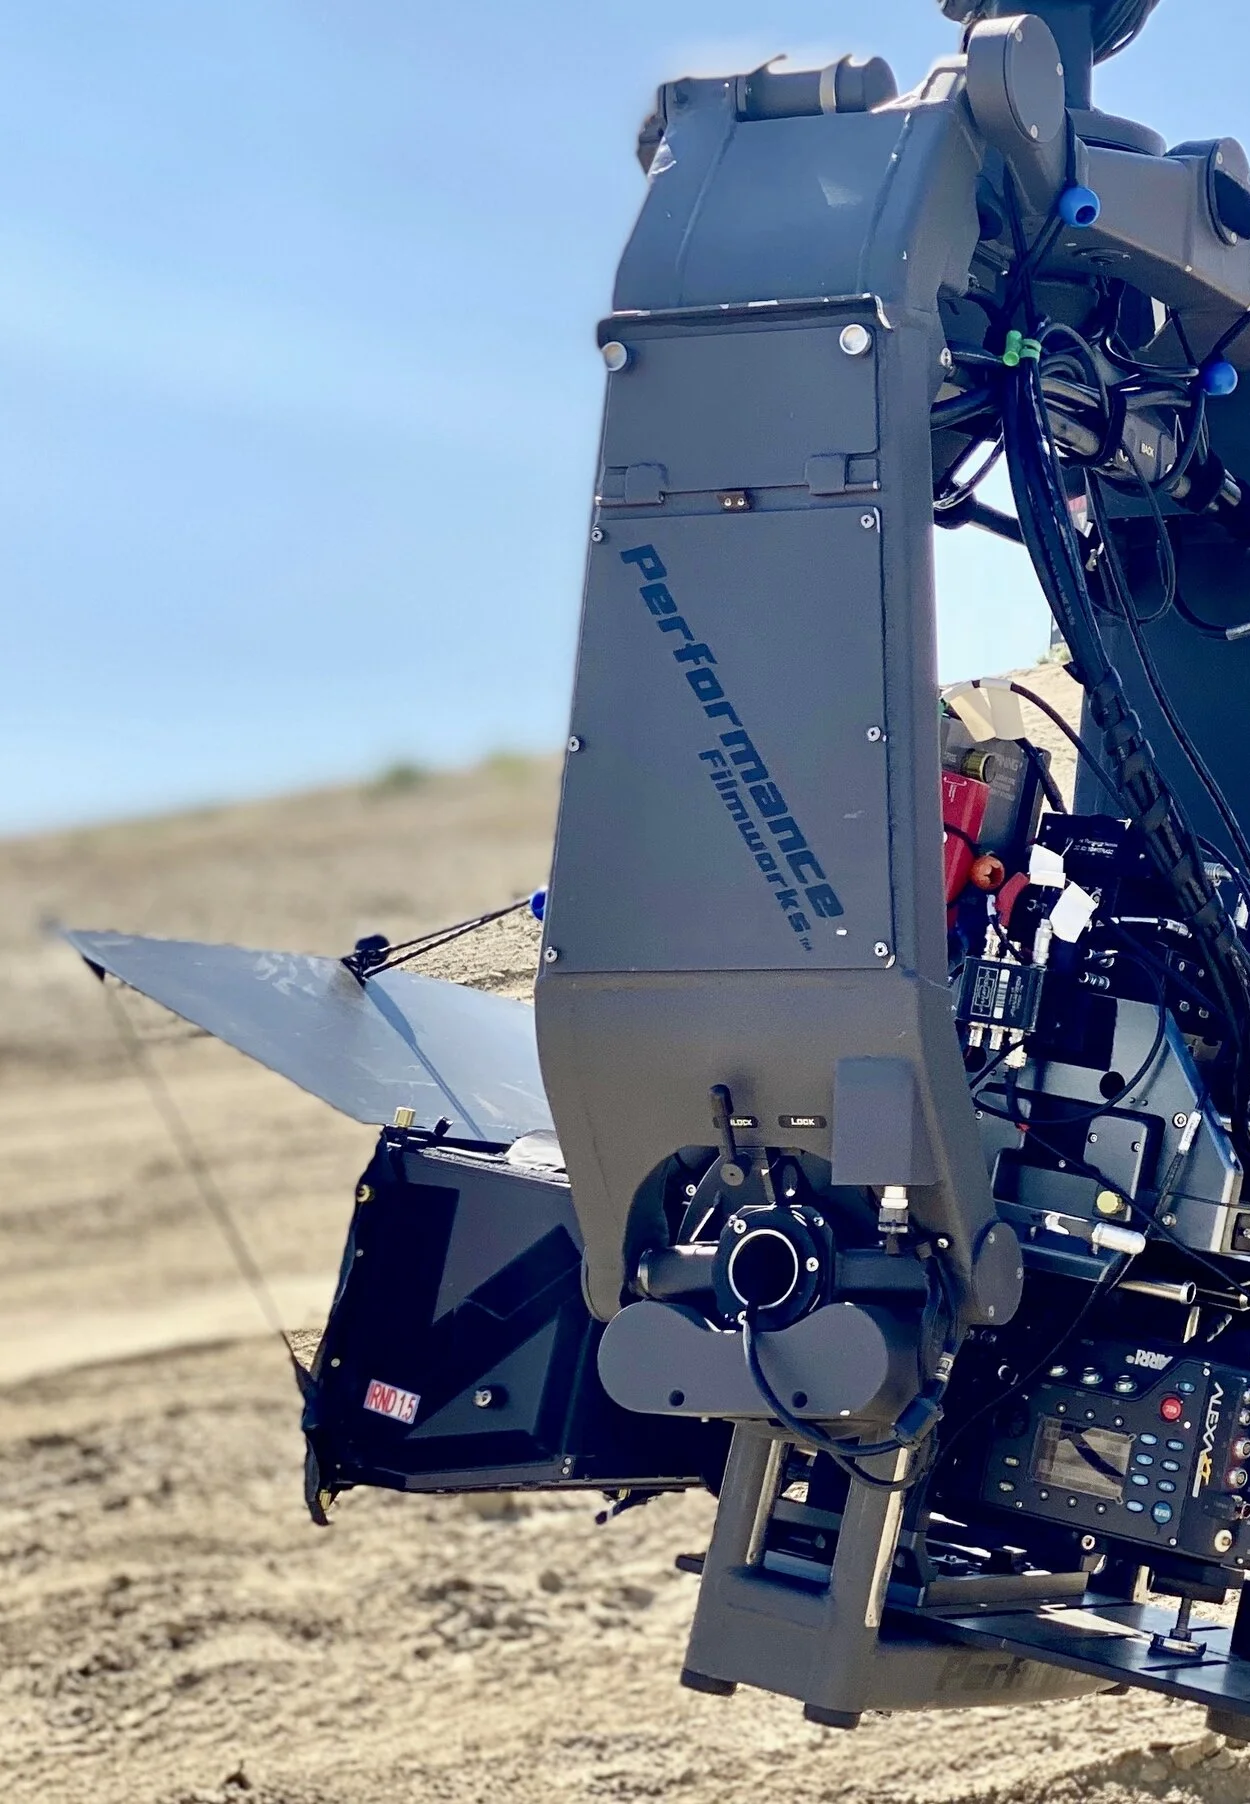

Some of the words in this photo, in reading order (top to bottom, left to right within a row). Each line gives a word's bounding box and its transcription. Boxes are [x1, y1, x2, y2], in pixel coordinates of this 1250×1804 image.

[1141, 442, 1155, 458] BACK
[619, 543, 845, 919] Performance
[729, 1118, 753, 1126] LOCK
[790, 1117, 816, 1126] LOCK
[367, 1382, 398, 1415] IRND
[397, 1393, 417, 1421] 1.5
[1200, 1381, 1224, 1454] ALEXA
